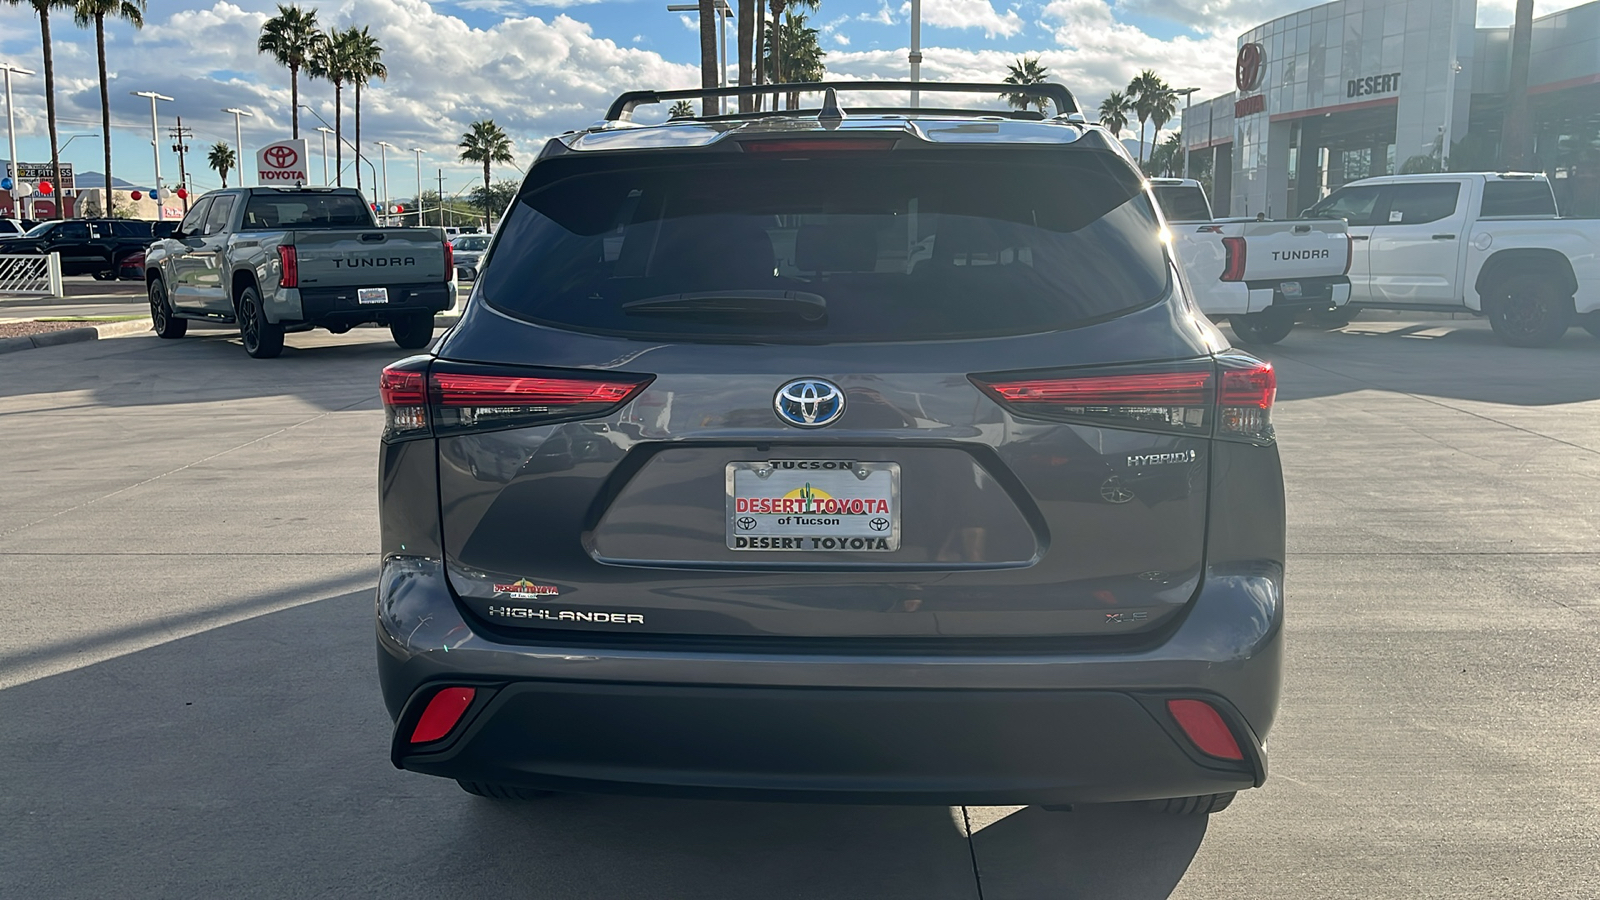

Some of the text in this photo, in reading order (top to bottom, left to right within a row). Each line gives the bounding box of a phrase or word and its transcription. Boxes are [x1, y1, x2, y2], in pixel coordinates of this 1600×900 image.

[1347, 73, 1401, 98] DESERT
[259, 170, 305, 180] TOYOTA
[1272, 249, 1329, 261] TUNDRA
[332, 257, 416, 268] TUNDRA
[770, 461, 853, 470] TUCSON
[1127, 452, 1185, 467] HYBRID
[736, 498, 889, 514] DESERT TOYOTA
[777, 516, 840, 526] of Tucson
[736, 537, 889, 550] DESERT TOYOTA
[489, 605, 645, 624] HIGHLANDER
[1105, 611, 1148, 623] XLE
